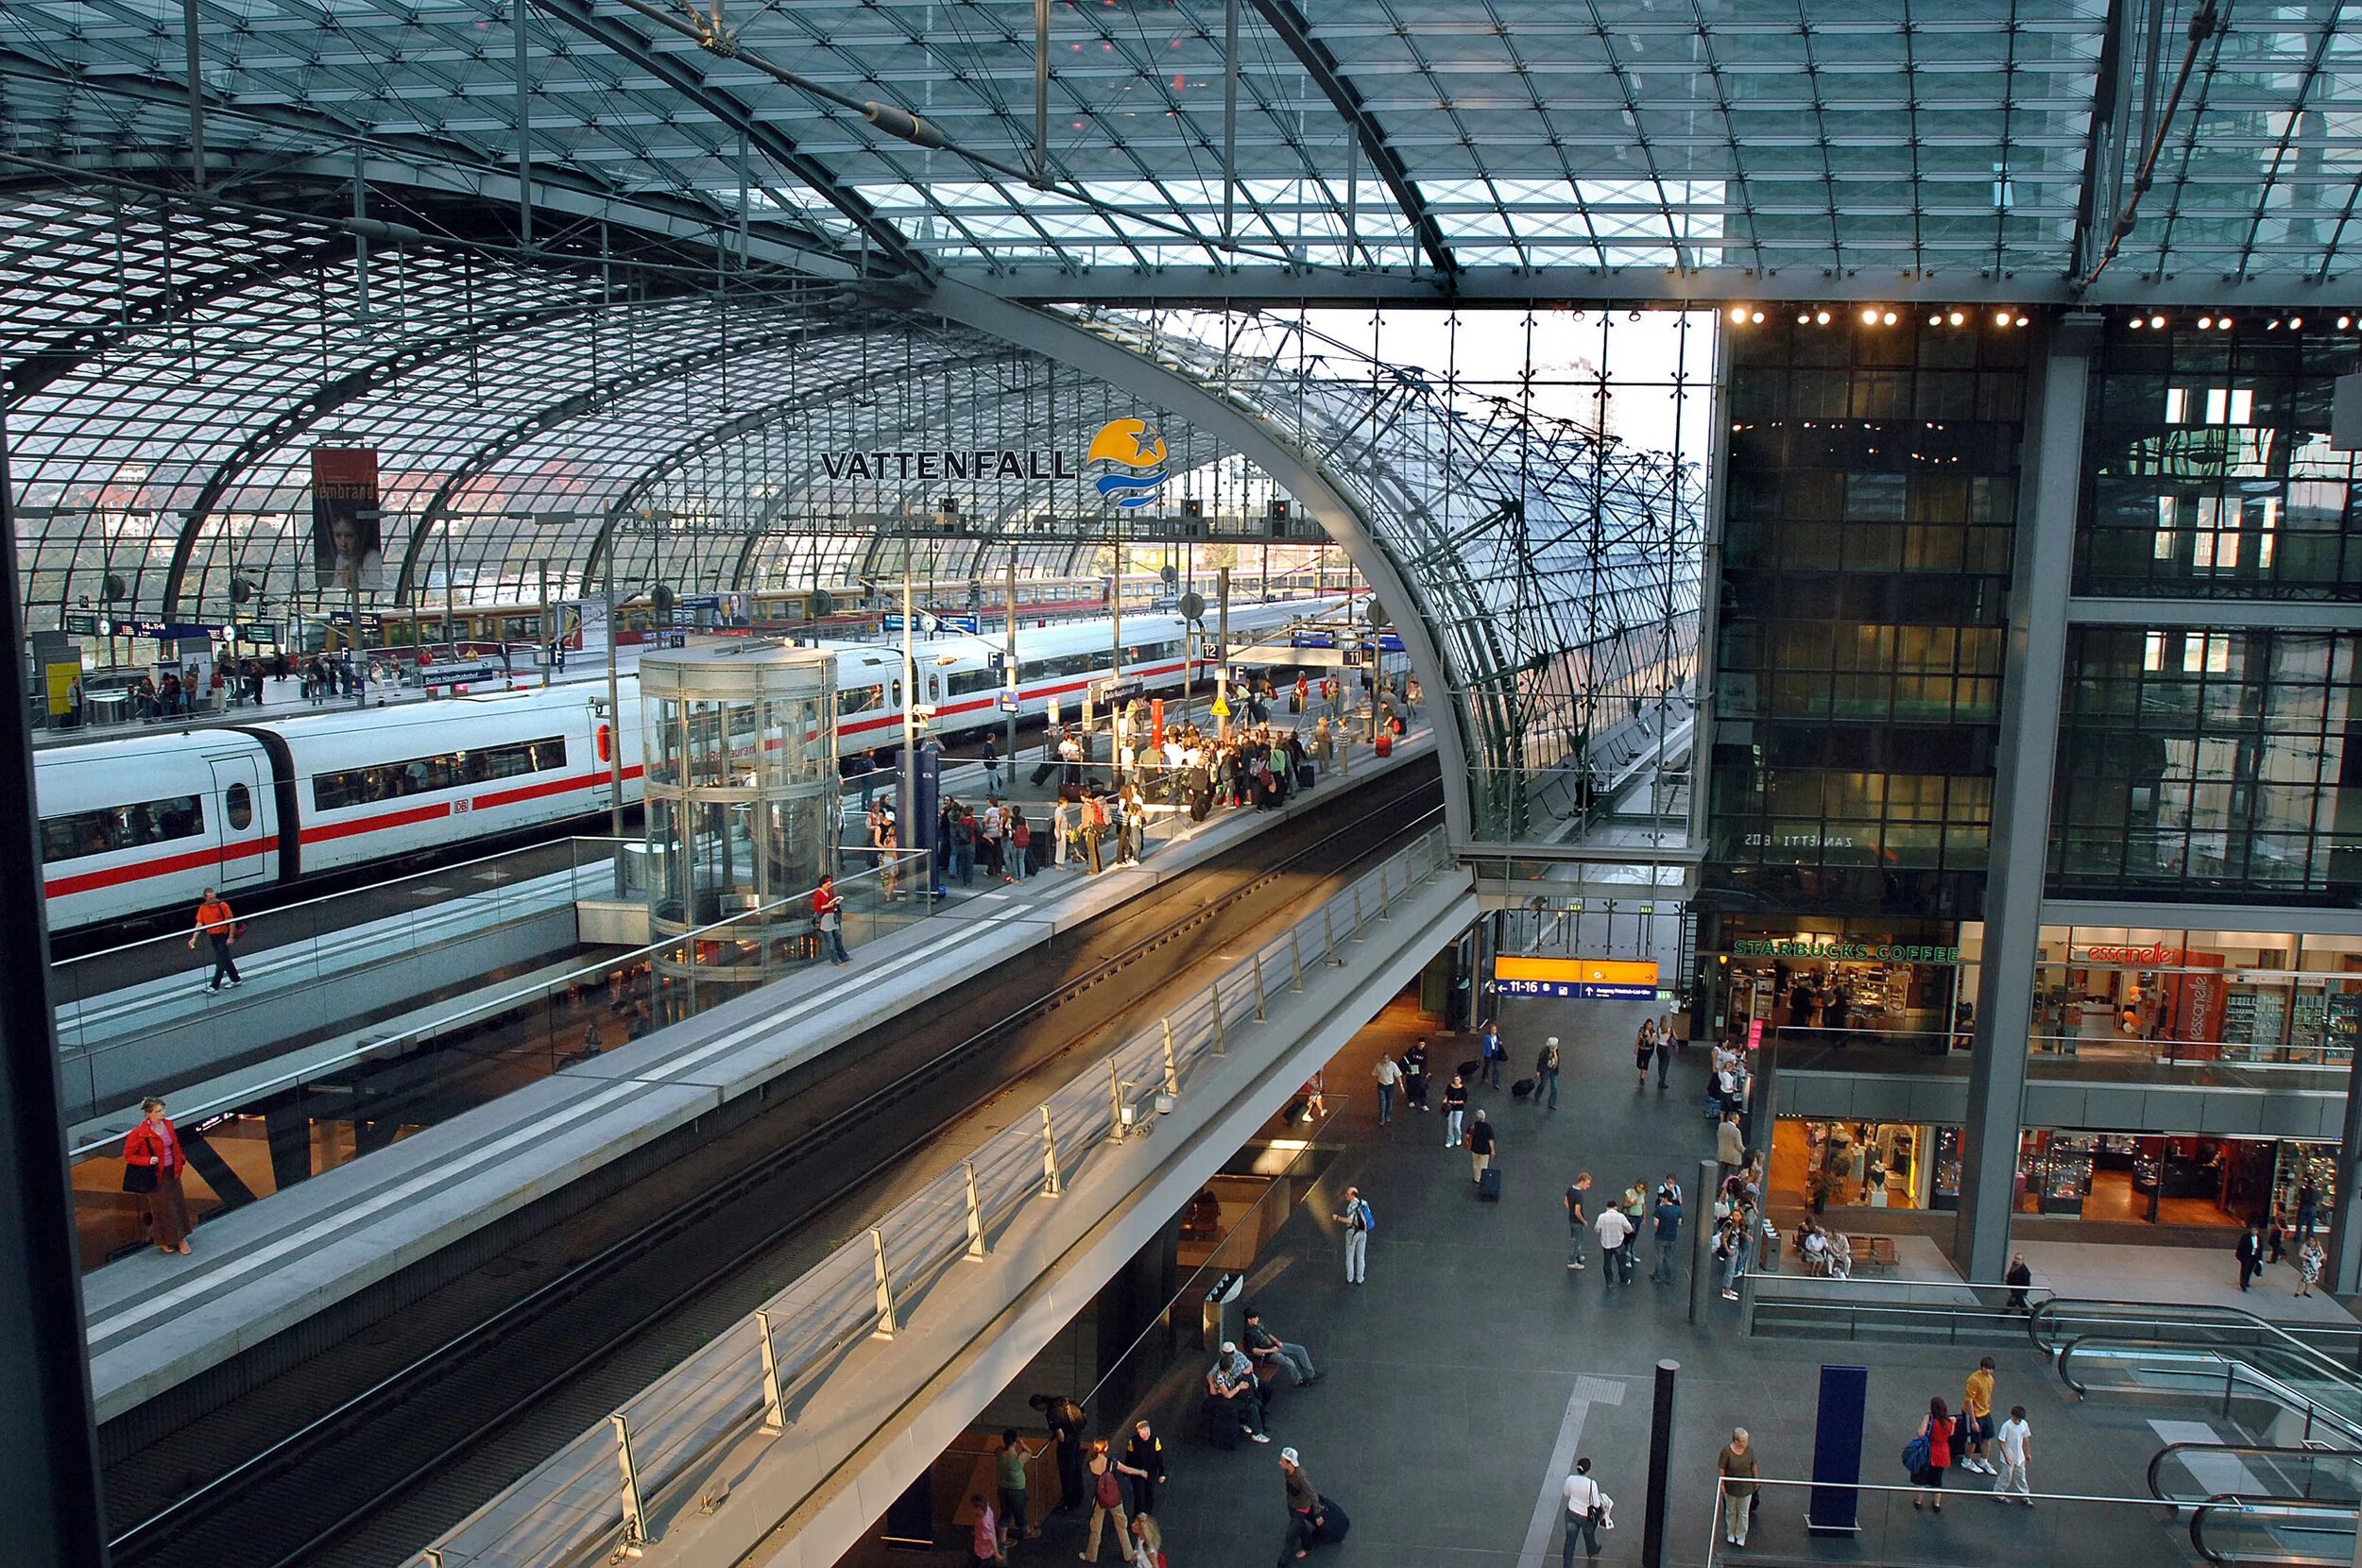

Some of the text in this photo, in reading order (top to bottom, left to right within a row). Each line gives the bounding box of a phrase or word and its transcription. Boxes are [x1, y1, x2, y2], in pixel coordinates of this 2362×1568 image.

[821, 451, 1076, 482] VATTENFALL
[672, 637, 681, 646] 14
[342, 647, 349, 660] F
[555, 650, 562, 664] F
[1204, 645, 1216, 657] 12
[1349, 651, 1359, 663] 11
[989, 653, 998, 667] F
[1235, 666, 1244, 681] F
[425, 676, 442, 685] Berlin
[455, 801, 468, 812] DB
[1734, 939, 1960, 963] STARBUCKS COFFEE
[2088, 942, 2174, 964] essanelle
[1510, 980, 1538, 993] 11-16
[2188, 976, 2208, 1036] essanelle
